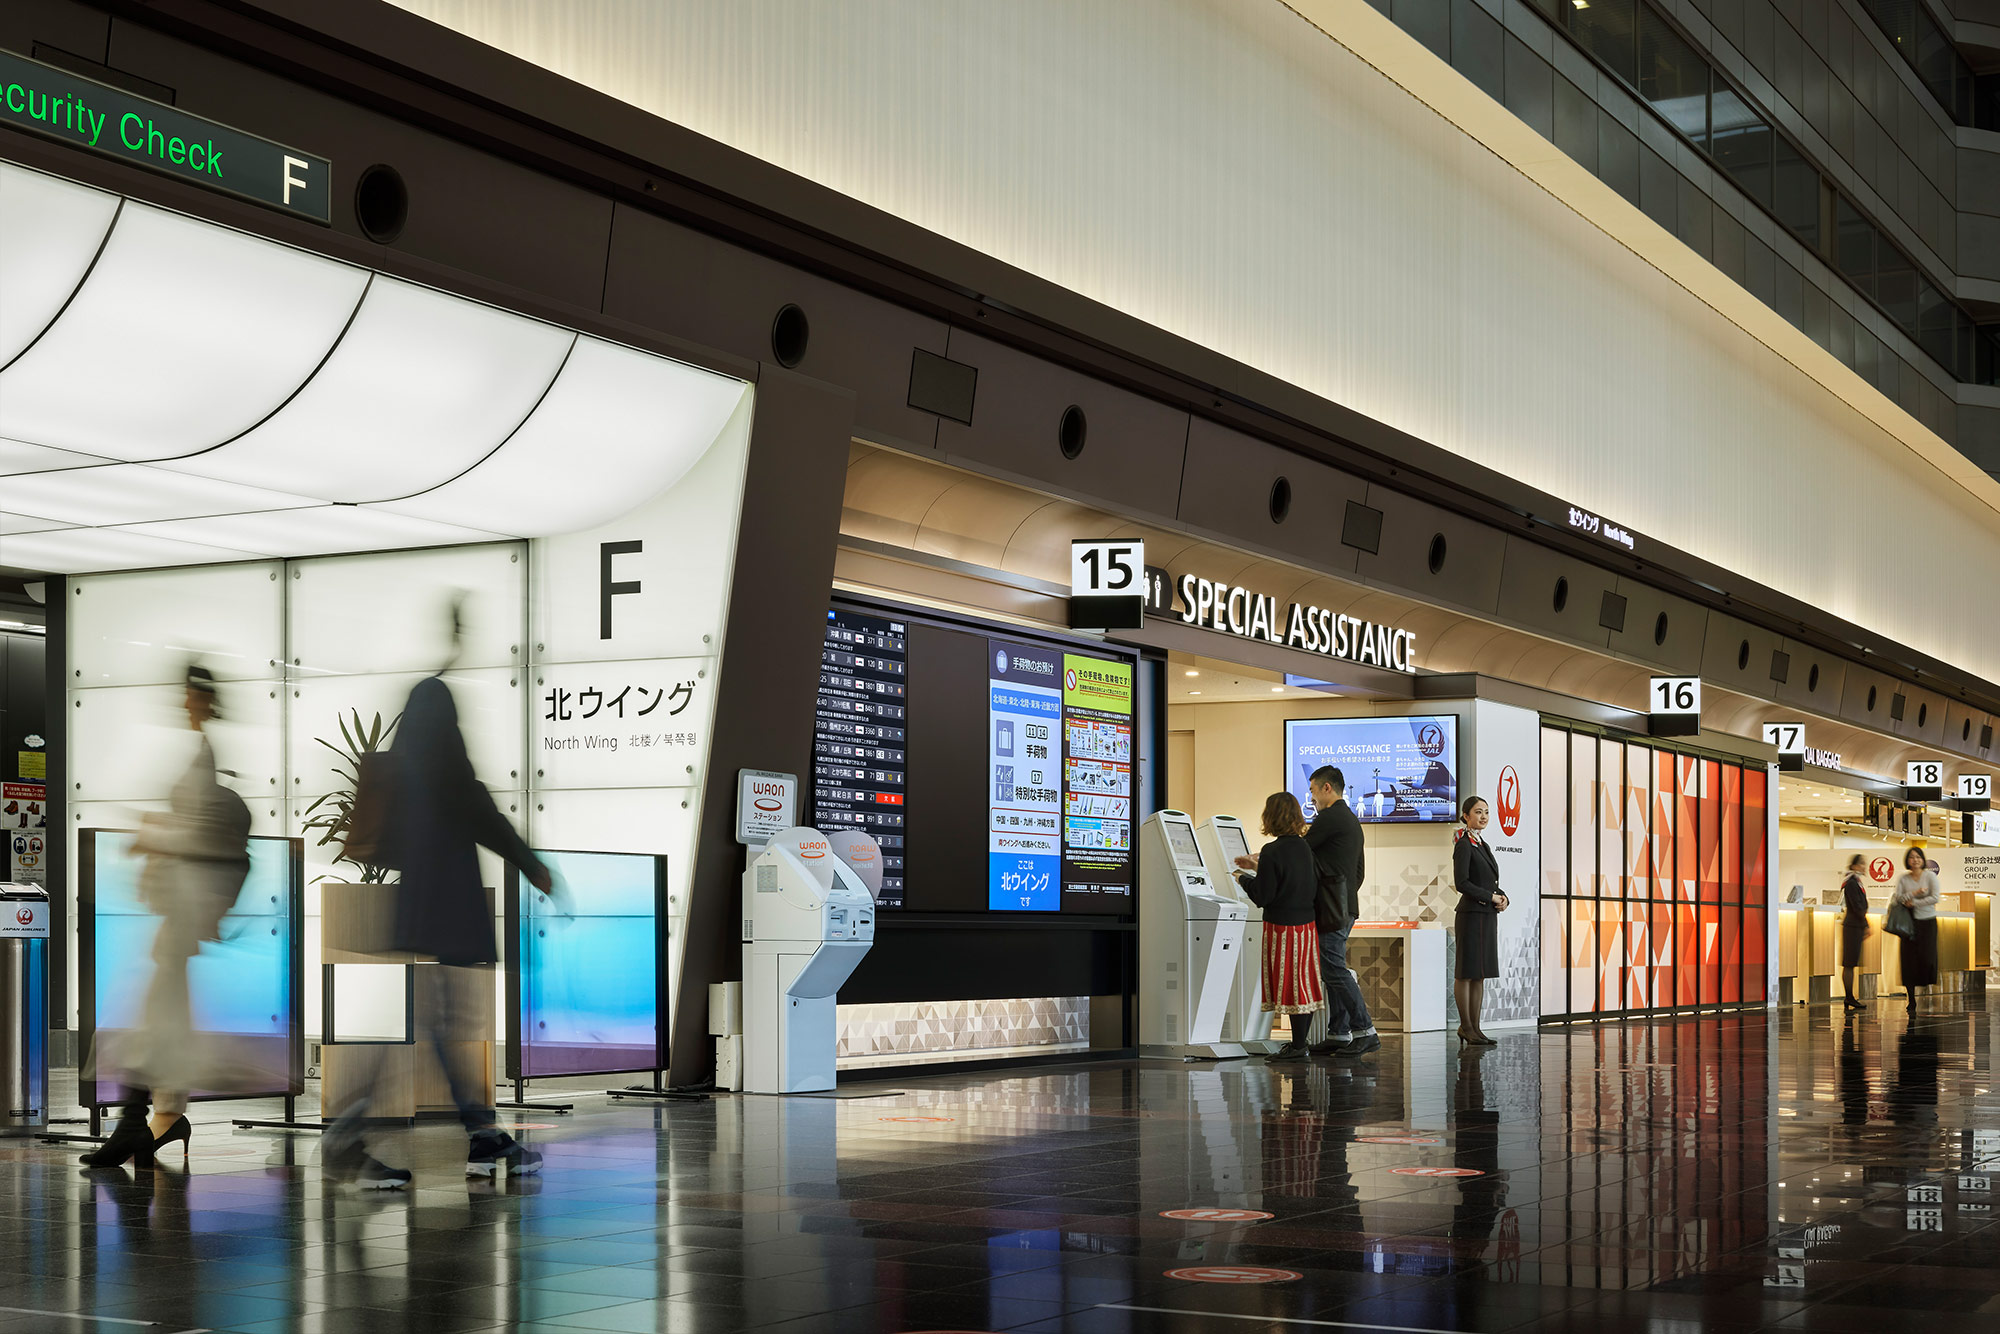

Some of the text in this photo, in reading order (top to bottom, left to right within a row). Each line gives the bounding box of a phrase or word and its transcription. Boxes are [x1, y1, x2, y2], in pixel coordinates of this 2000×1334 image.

[0, 82, 224, 178] curity Check
[283, 154, 309, 205] F
[1080, 547, 1133, 590] 15
[600, 540, 643, 640] F
[1181, 573, 1416, 673] SPECIAL ASSISTANCE
[545, 680, 696, 721] 北ウイング
[1657, 681, 1694, 709] 16
[545, 735, 618, 752] North Wing
[1769, 727, 1799, 750] 17
[1026, 744, 1047, 759] 手荷物
[1299, 744, 1391, 755] SPECIAL ASSISTANCE
[1912, 764, 1938, 784] 18
[753, 782, 785, 797] WAON
[1015, 786, 1057, 803] 特別な手荷物
[1963, 778, 1987, 795] 19
[753, 812, 783, 821] ステーション
[1503, 816, 1516, 828] JAL
[799, 842, 826, 850] WAON
[1018, 860, 1034, 870] ここは
[1001, 872, 1049, 891] 北ウイング
[1020, 896, 1031, 907] です
